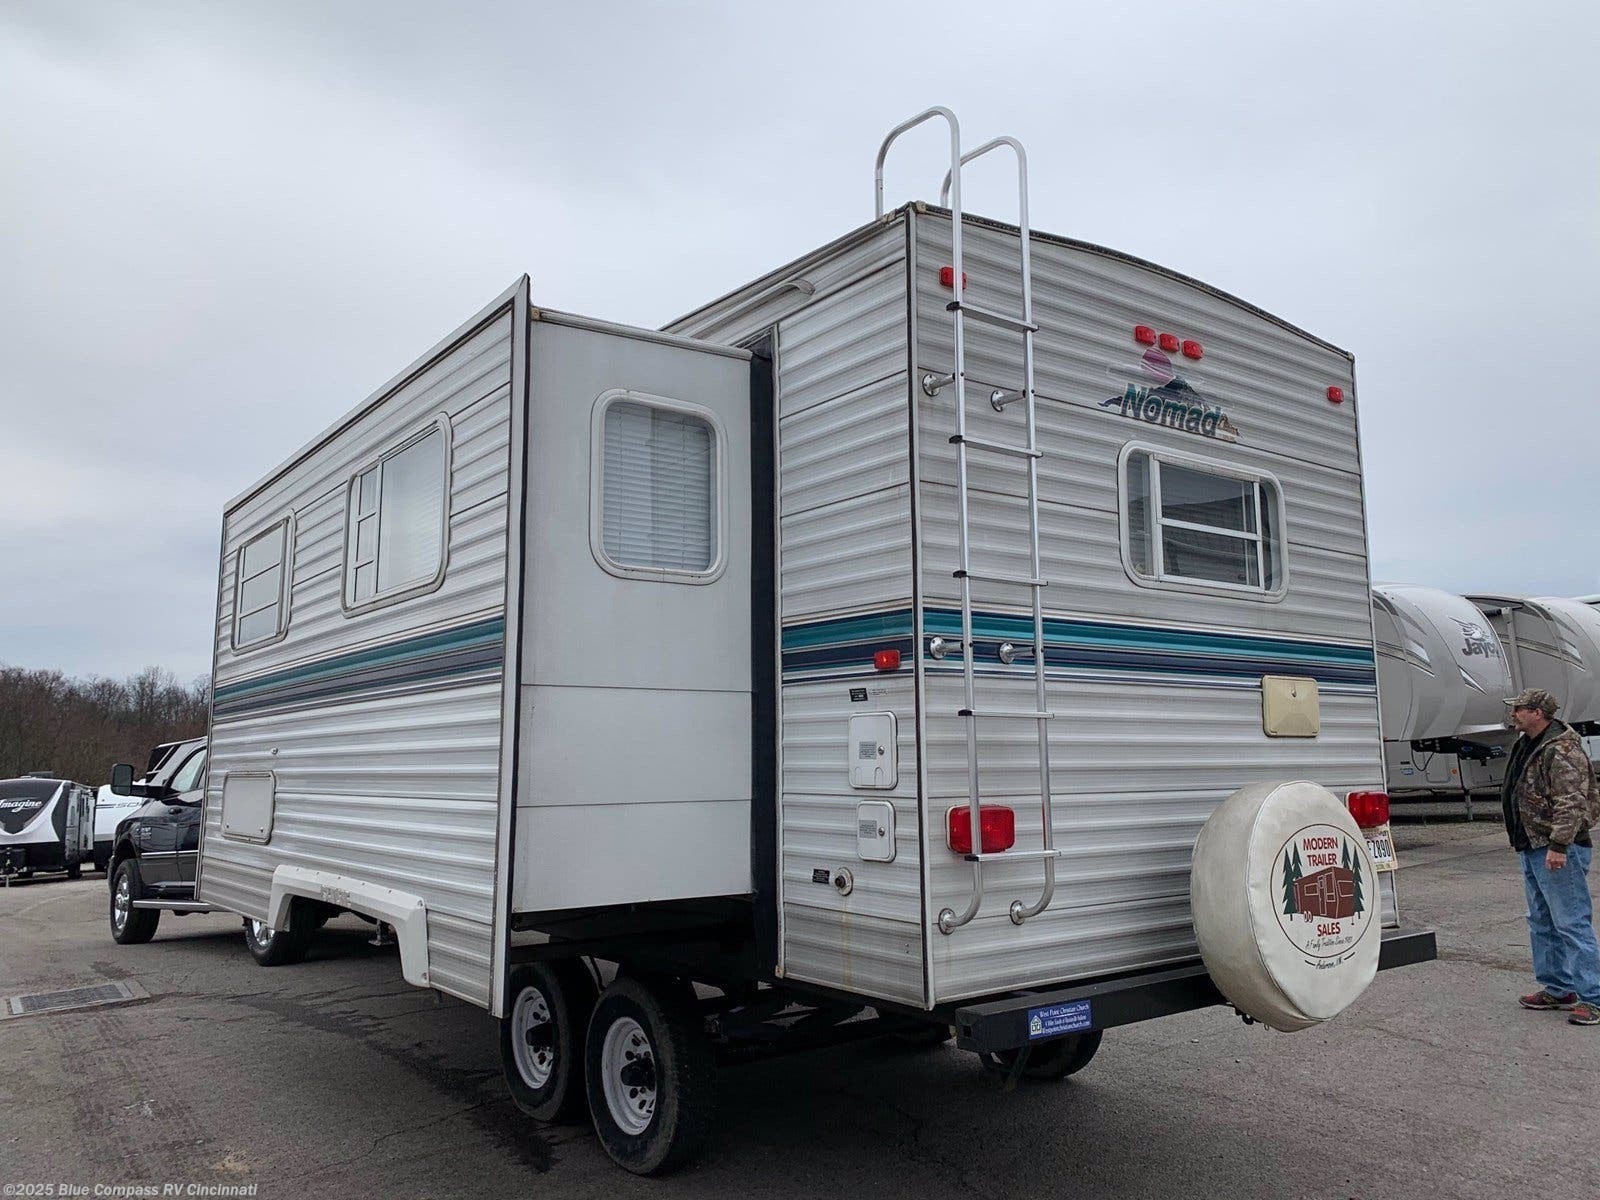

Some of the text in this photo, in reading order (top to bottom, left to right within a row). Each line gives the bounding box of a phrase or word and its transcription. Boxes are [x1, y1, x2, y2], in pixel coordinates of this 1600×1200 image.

[1120, 382, 1222, 437] Nomad
[0, 798, 43, 813] Imagine
[1303, 837, 1339, 851] MODERN
[1307, 853, 1337, 867] TRAILER
[1317, 922, 1341, 937] SALES
[1077, 1003, 1090, 1012] Church
